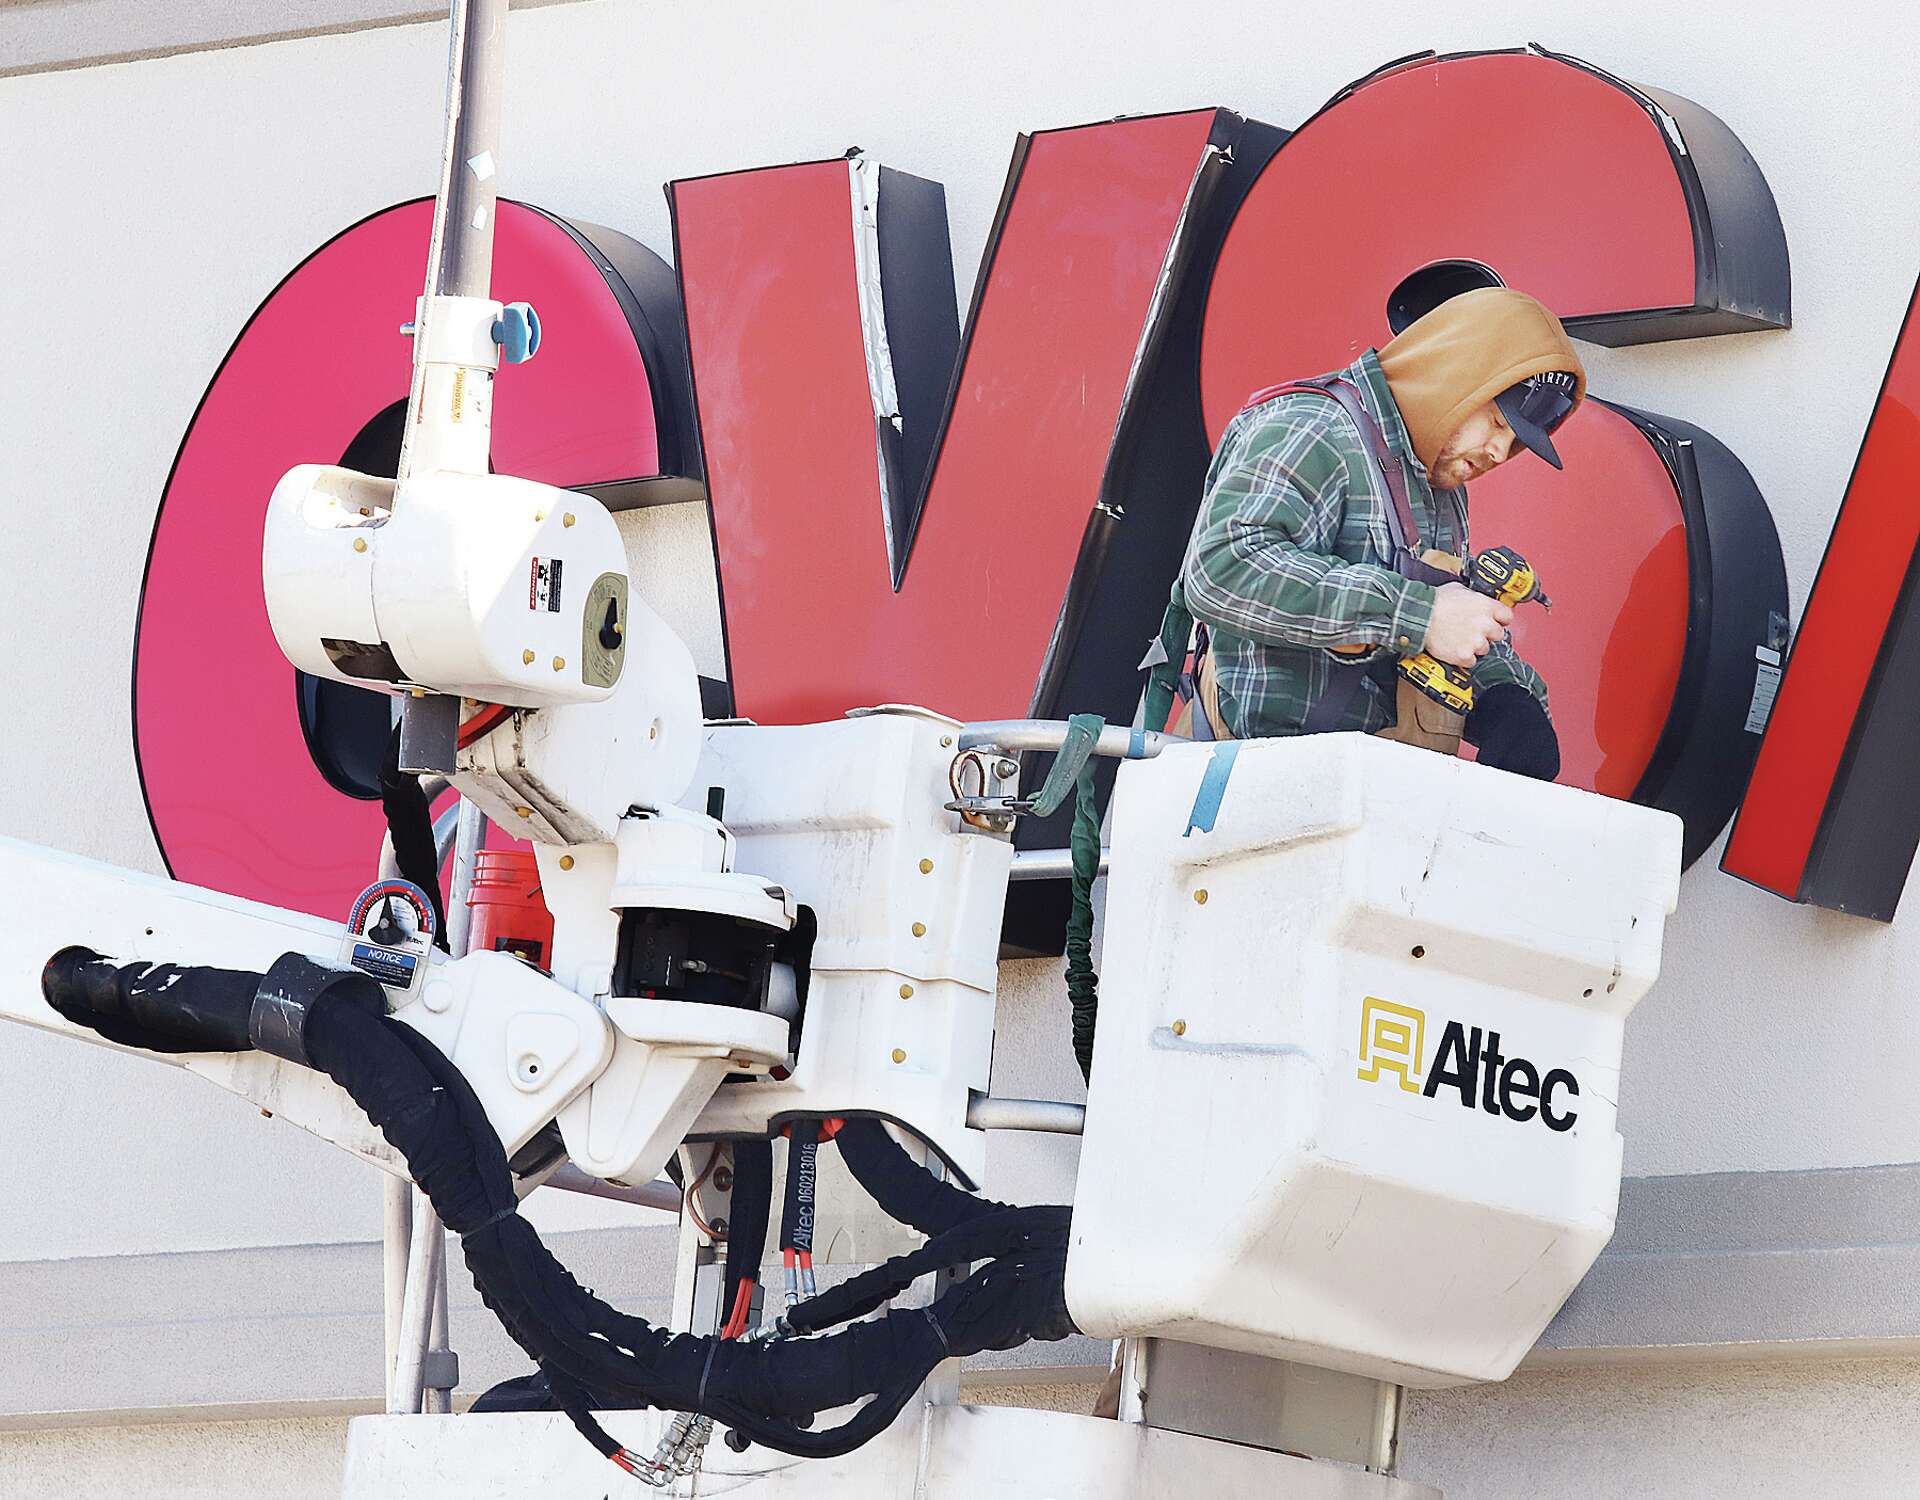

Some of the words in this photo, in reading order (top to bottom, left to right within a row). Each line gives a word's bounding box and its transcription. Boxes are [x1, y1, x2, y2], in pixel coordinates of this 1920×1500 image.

[454, 373, 463, 410] WARNING
[367, 949, 403, 964] NOTICE
[1423, 1020, 1579, 1132] Altec
[798, 1143, 816, 1203] 060213016
[793, 1206, 813, 1250] Altec
